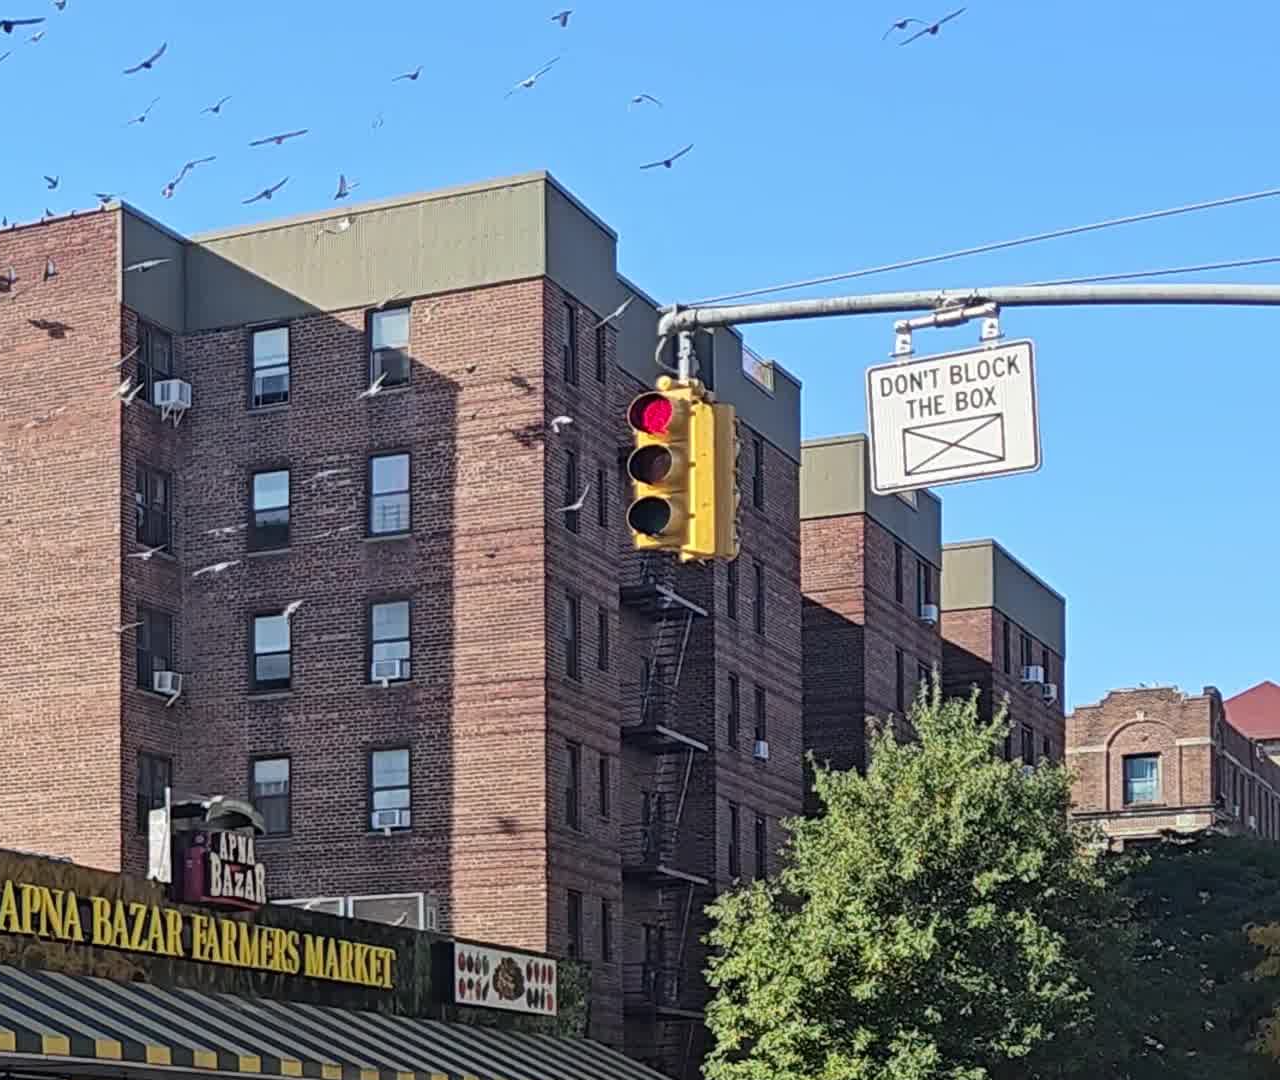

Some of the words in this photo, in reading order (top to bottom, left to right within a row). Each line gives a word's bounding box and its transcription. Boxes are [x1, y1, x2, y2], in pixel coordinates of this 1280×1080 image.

[880, 367, 940, 398] DON'T
[949, 354, 1021, 385] BLOCK
[906, 394, 946, 419] THE
[955, 386, 997, 411] BOX
[220, 831, 256, 867] APNA
[209, 852, 267, 904] BAZAR
[90, 896, 185, 957] BAZAR
[191, 913, 301, 975] FARMERS
[302, 933, 397, 990] MARKET
